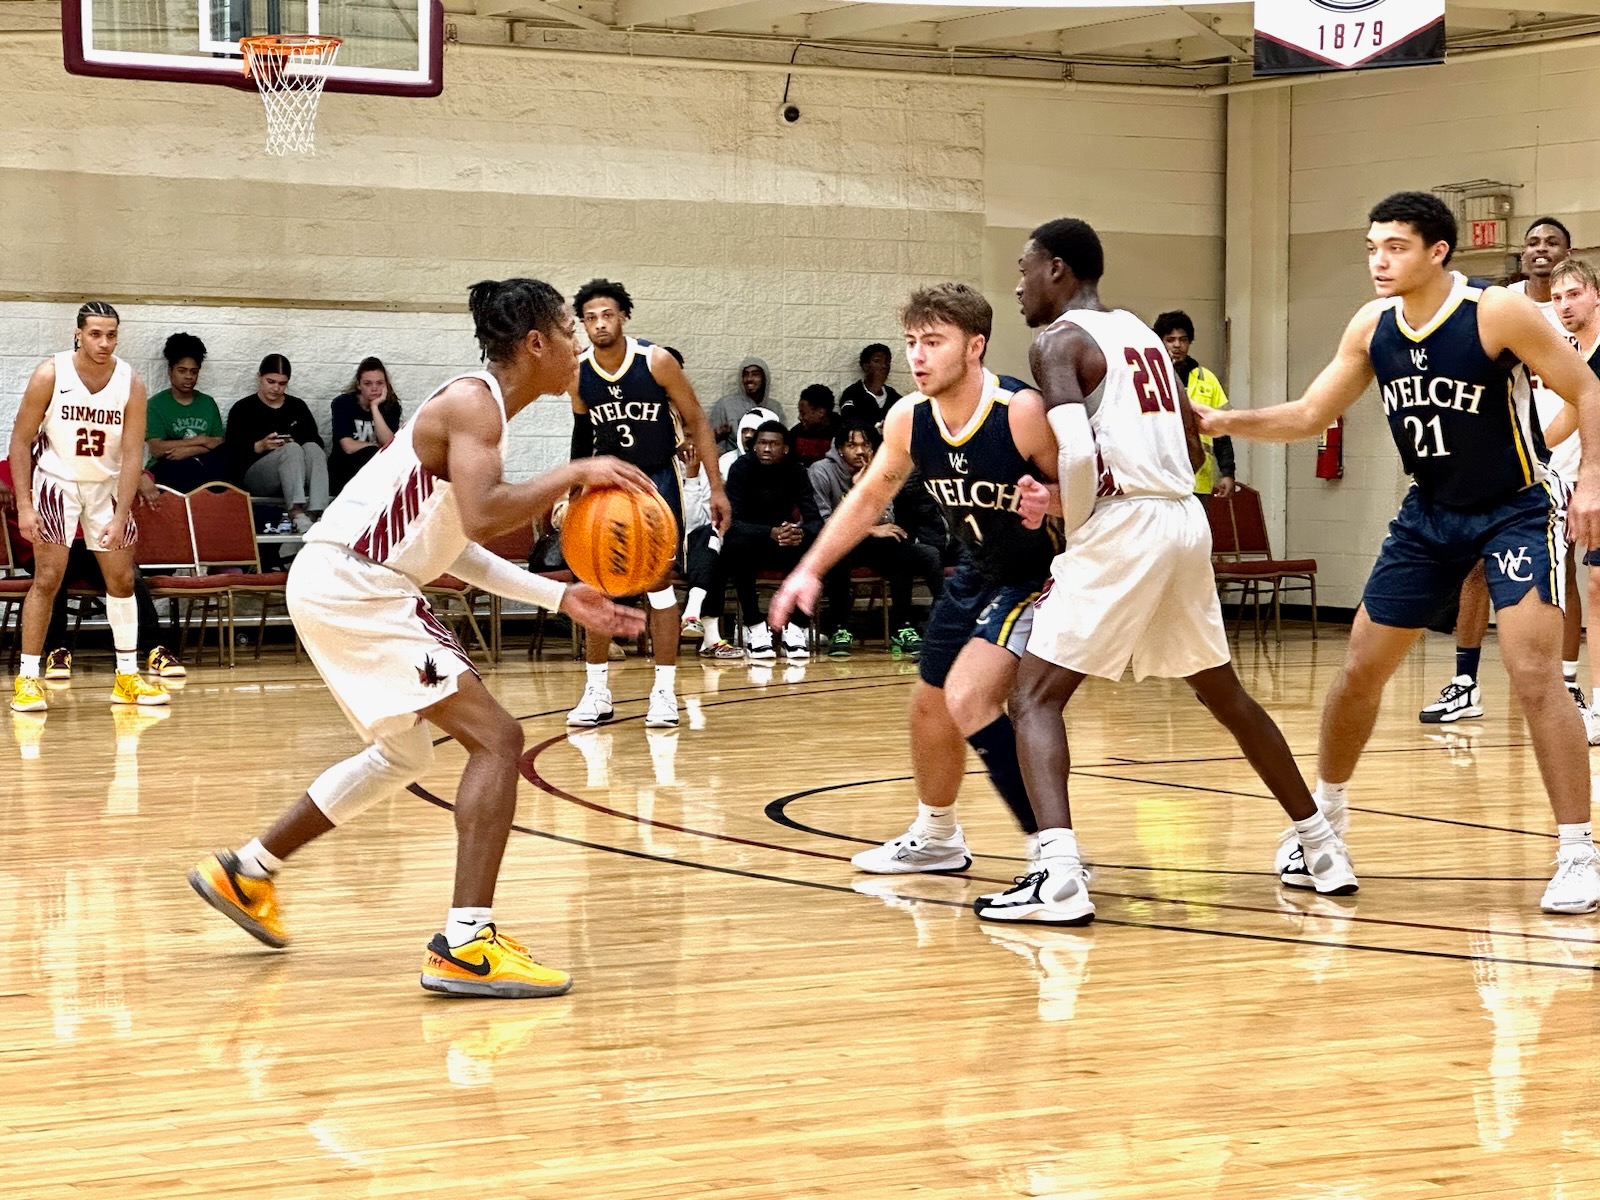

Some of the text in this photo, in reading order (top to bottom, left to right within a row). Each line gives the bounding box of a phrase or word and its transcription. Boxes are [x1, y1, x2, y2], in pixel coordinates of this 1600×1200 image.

[1318, 20, 1383, 50] 1879
[1472, 222, 1496, 247] EXIT
[1123, 346, 1176, 414] 20
[1382, 375, 1485, 416] WELCH
[61, 405, 122, 425] SIMMONS
[588, 401, 661, 426] WELCH
[75, 427, 106, 457] 23
[616, 424, 634, 448] 3
[1403, 413, 1450, 458] 21
[964, 513, 984, 546] 1
[1492, 546, 1533, 582] WC
